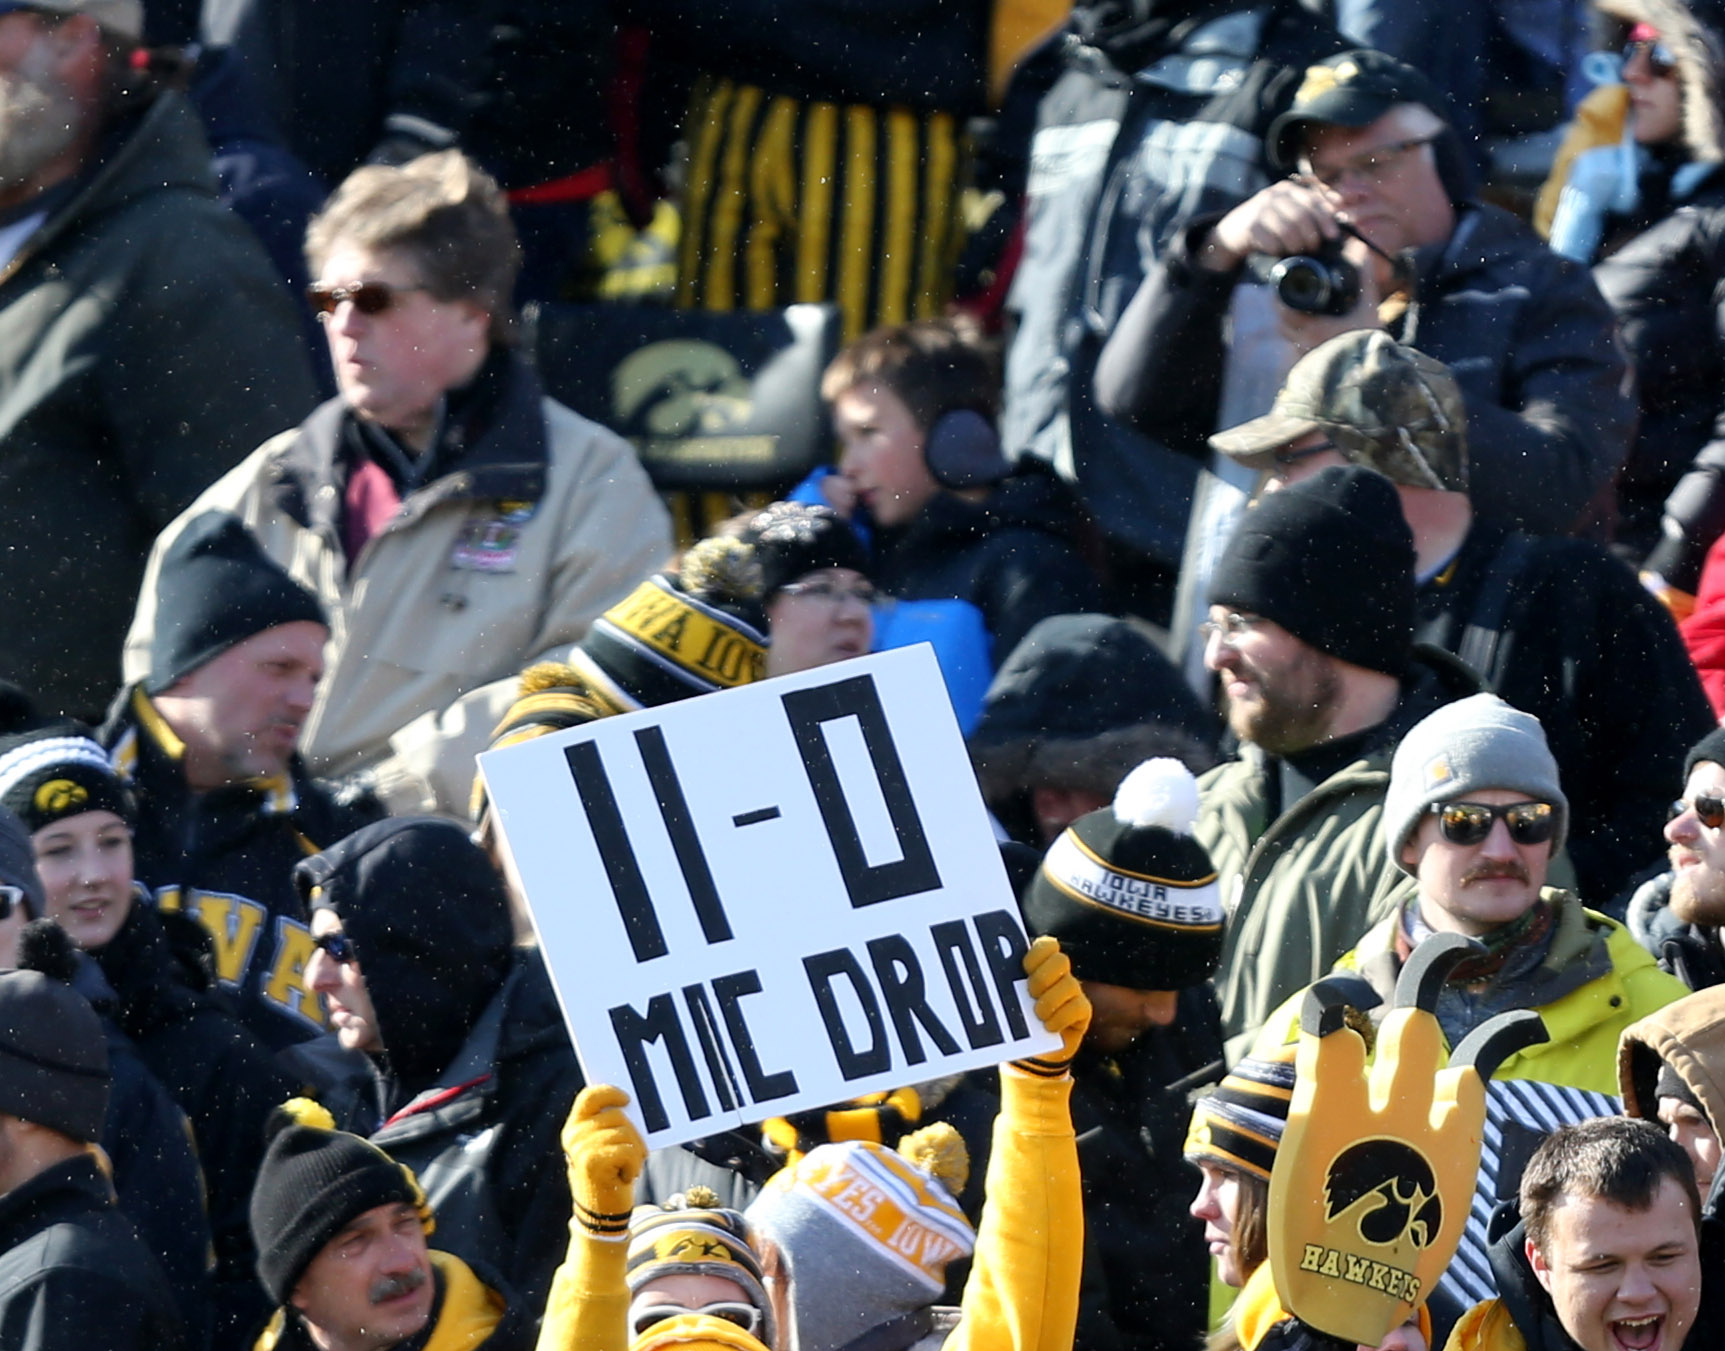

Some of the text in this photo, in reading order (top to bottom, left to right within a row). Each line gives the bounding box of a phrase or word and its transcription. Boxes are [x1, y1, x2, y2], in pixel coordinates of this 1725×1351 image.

[563, 673, 943, 963] 11-0
[1101, 870, 1168, 901] IOWA
[150, 884, 328, 1036] WA
[608, 908, 1031, 1136] MIC DROP
